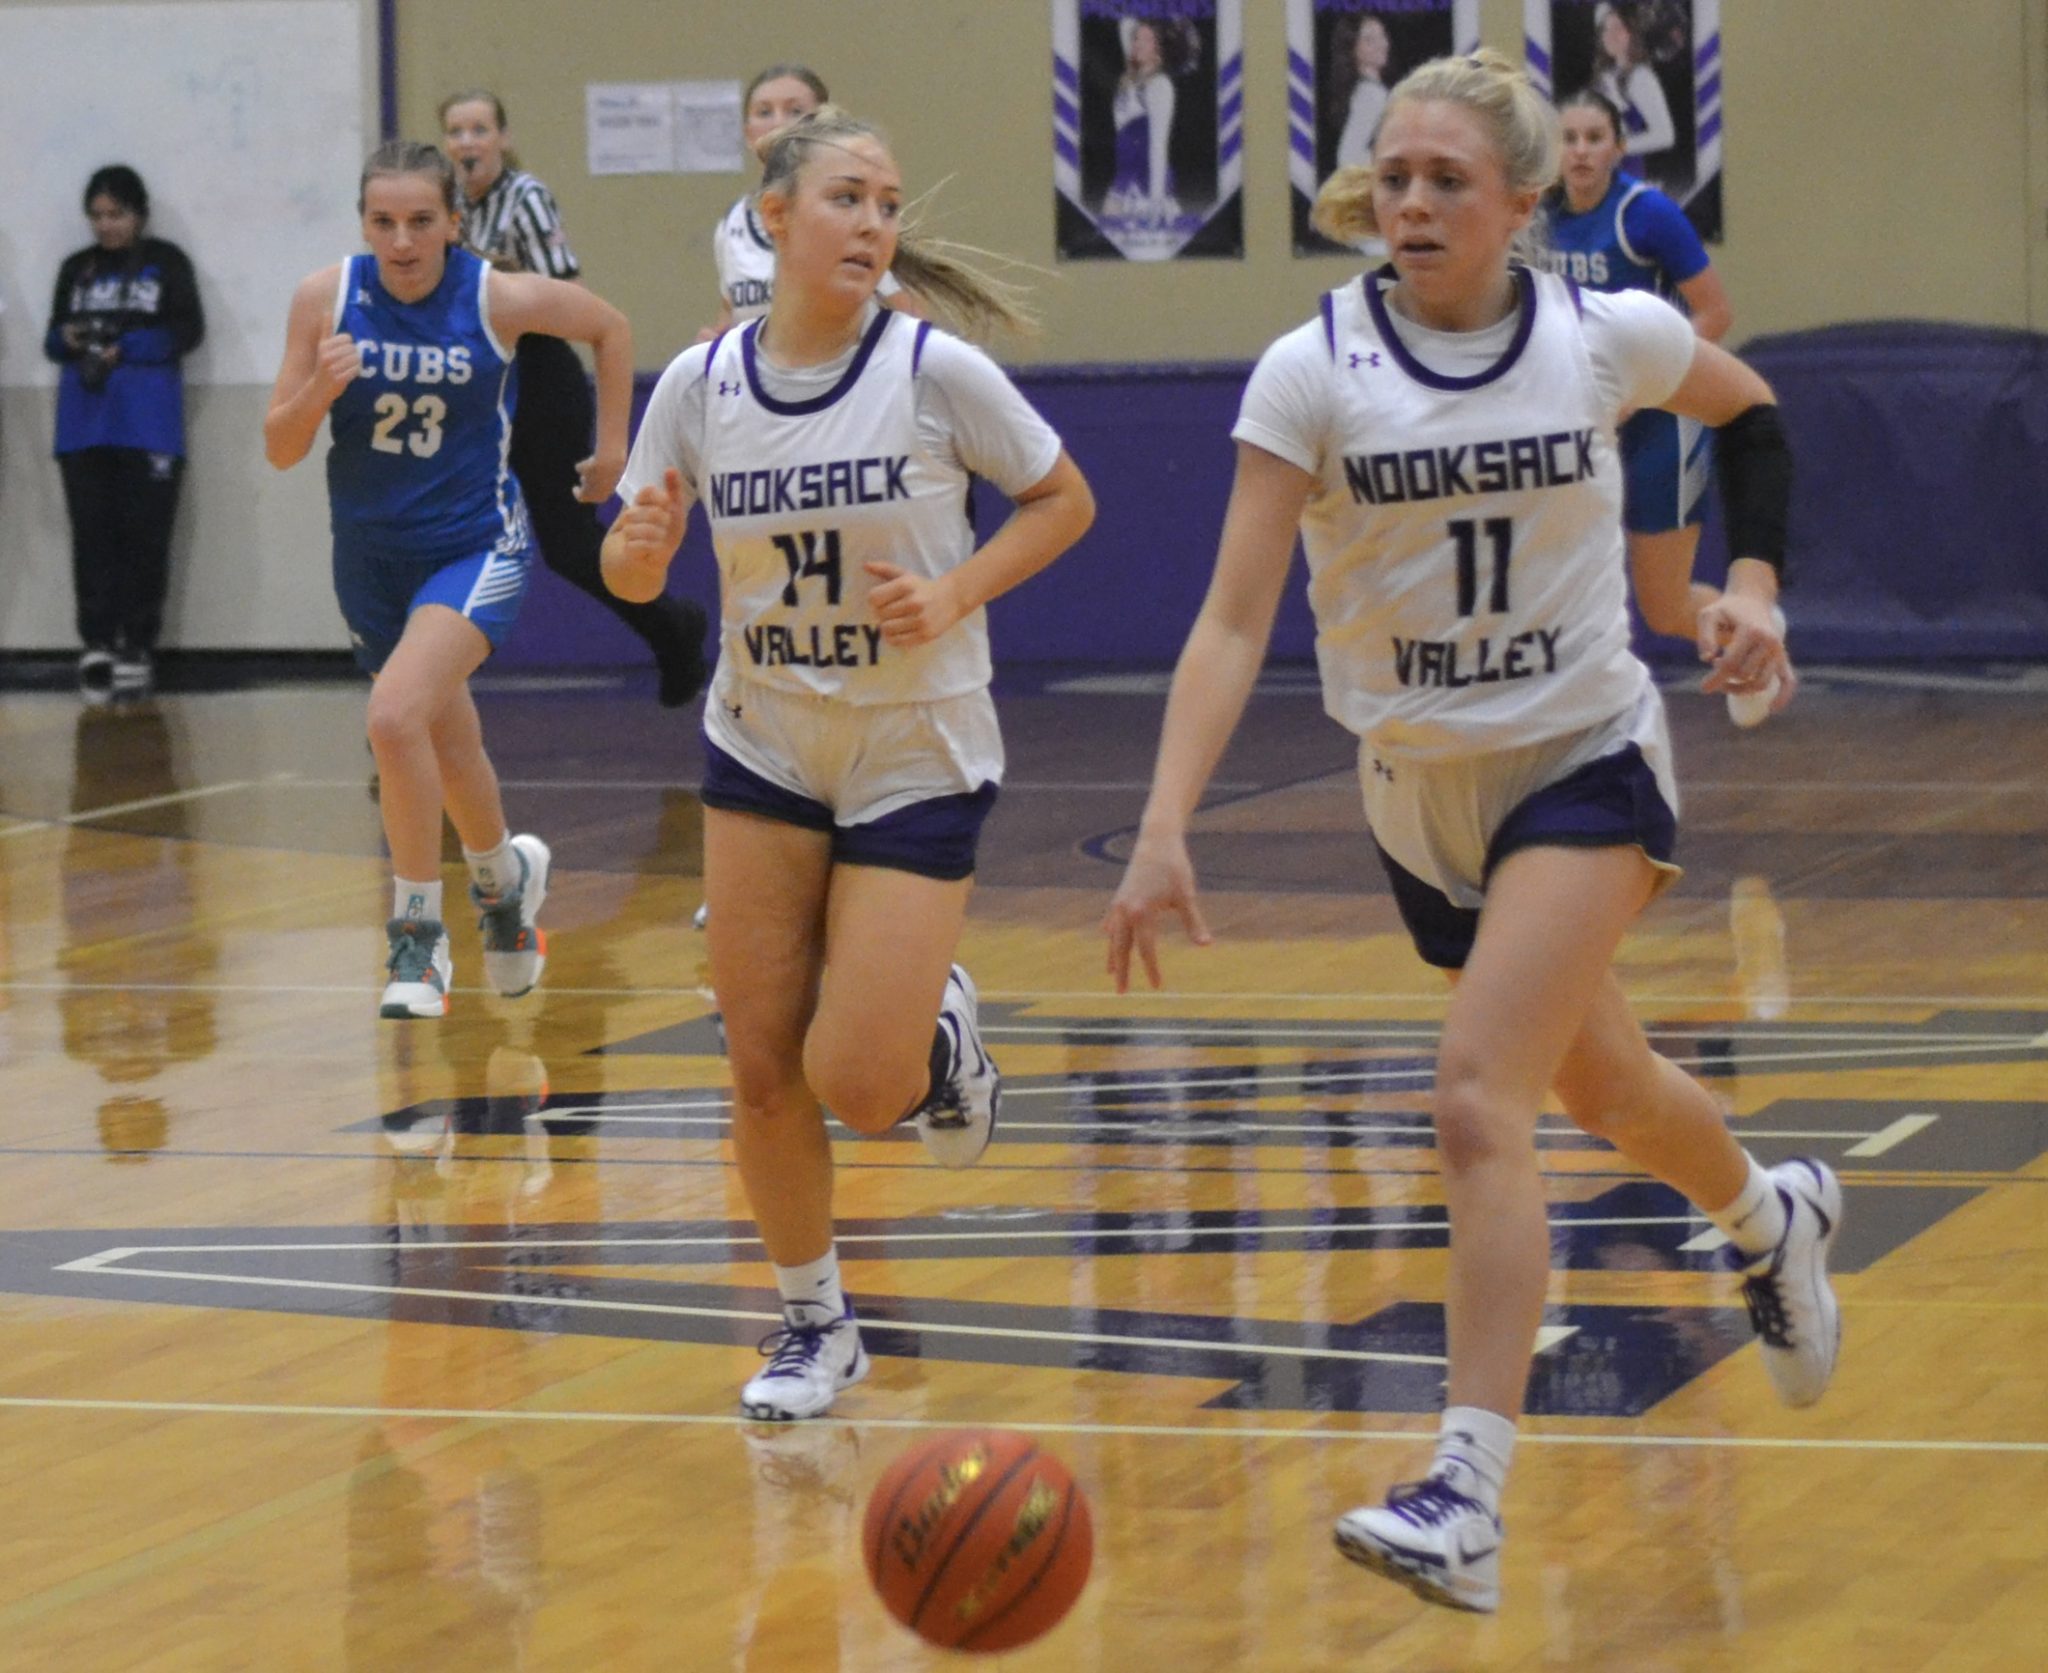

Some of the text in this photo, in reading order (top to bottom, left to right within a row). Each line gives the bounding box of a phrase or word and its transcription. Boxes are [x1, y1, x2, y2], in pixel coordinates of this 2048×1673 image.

[355, 339, 473, 385] CUBS
[371, 392, 448, 459] 23
[711, 455, 912, 518] NOOKSACK
[1343, 427, 1596, 504] NOOKSACK
[771, 529, 842, 608] 14
[1447, 516, 1513, 617] 11
[744, 624, 883, 668] VALLEY
[1392, 626, 1562, 688] VALLEY
